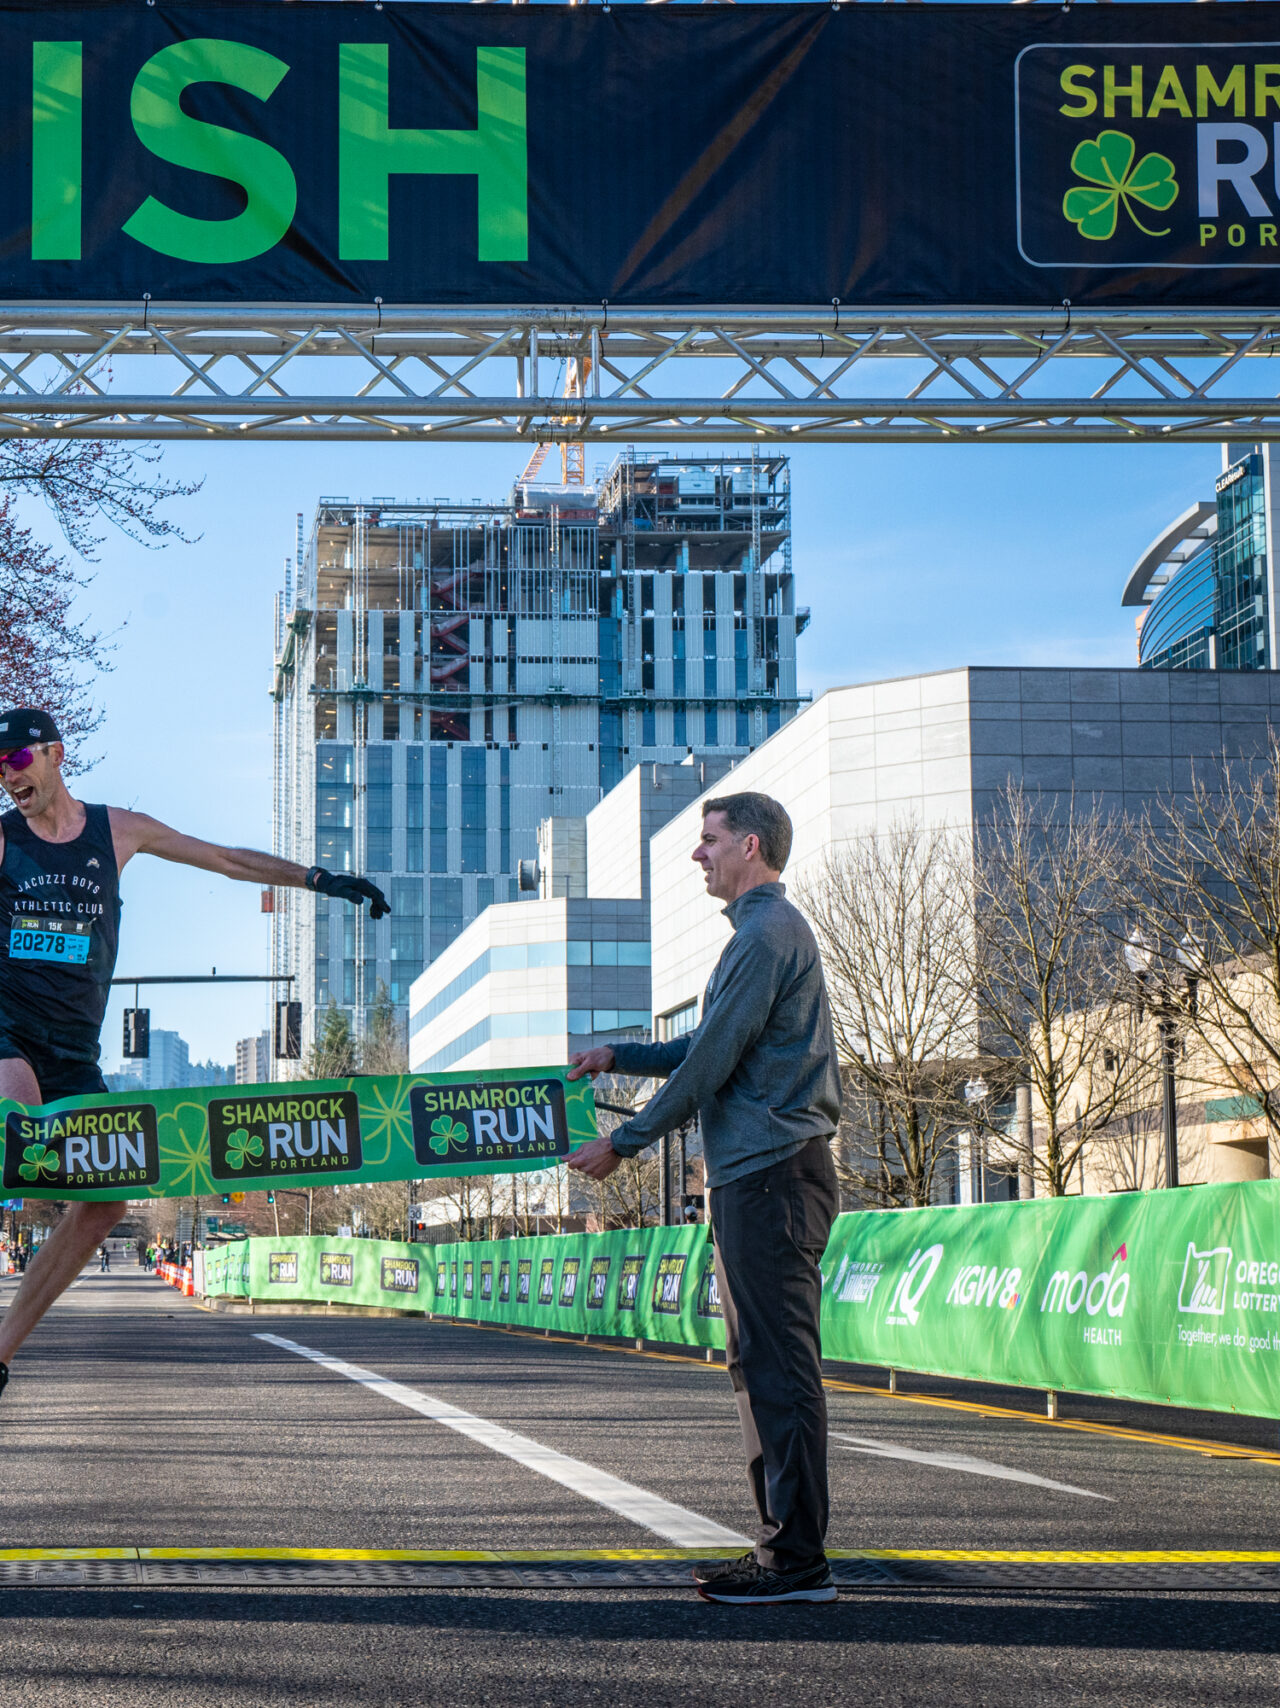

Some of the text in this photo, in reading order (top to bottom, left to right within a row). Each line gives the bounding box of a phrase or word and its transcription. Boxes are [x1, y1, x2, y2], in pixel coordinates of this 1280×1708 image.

[1196, 122, 1280, 217] R
[18, 874, 100, 894] JACUZZI BOYS
[14, 901, 104, 915] ATHLETIC CLUB
[48, 922, 63, 932] 15K
[13, 932, 66, 954] 20278
[424, 1085, 552, 1112] SHAMROCK
[20, 1110, 143, 1140] SHAMROCK
[222, 1098, 345, 1126] SHAMROCK
[472, 1105, 555, 1144] RUN
[268, 1118, 348, 1159] RUN
[476, 1141, 557, 1156] PORTLAND
[65, 1132, 147, 1173] RUN
[270, 1155, 350, 1169] PORTLAND
[66, 1169, 147, 1184] PORTLAND
[331, 1264, 351, 1280] RUN
[395, 1269, 417, 1287] RUN
[889, 1243, 944, 1326] iQ
[1235, 1260, 1280, 1286] OREG
[945, 1265, 1021, 1309] KGW8
[1040, 1259, 1130, 1317] moda
[1233, 1291, 1280, 1313] LOTTER
[1083, 1327, 1122, 1346] HEALTH
[1177, 1323, 1217, 1347] Together,
[1219, 1333, 1232, 1345] we
[1233, 1328, 1246, 1346] do
[1249, 1330, 1271, 1353] good
